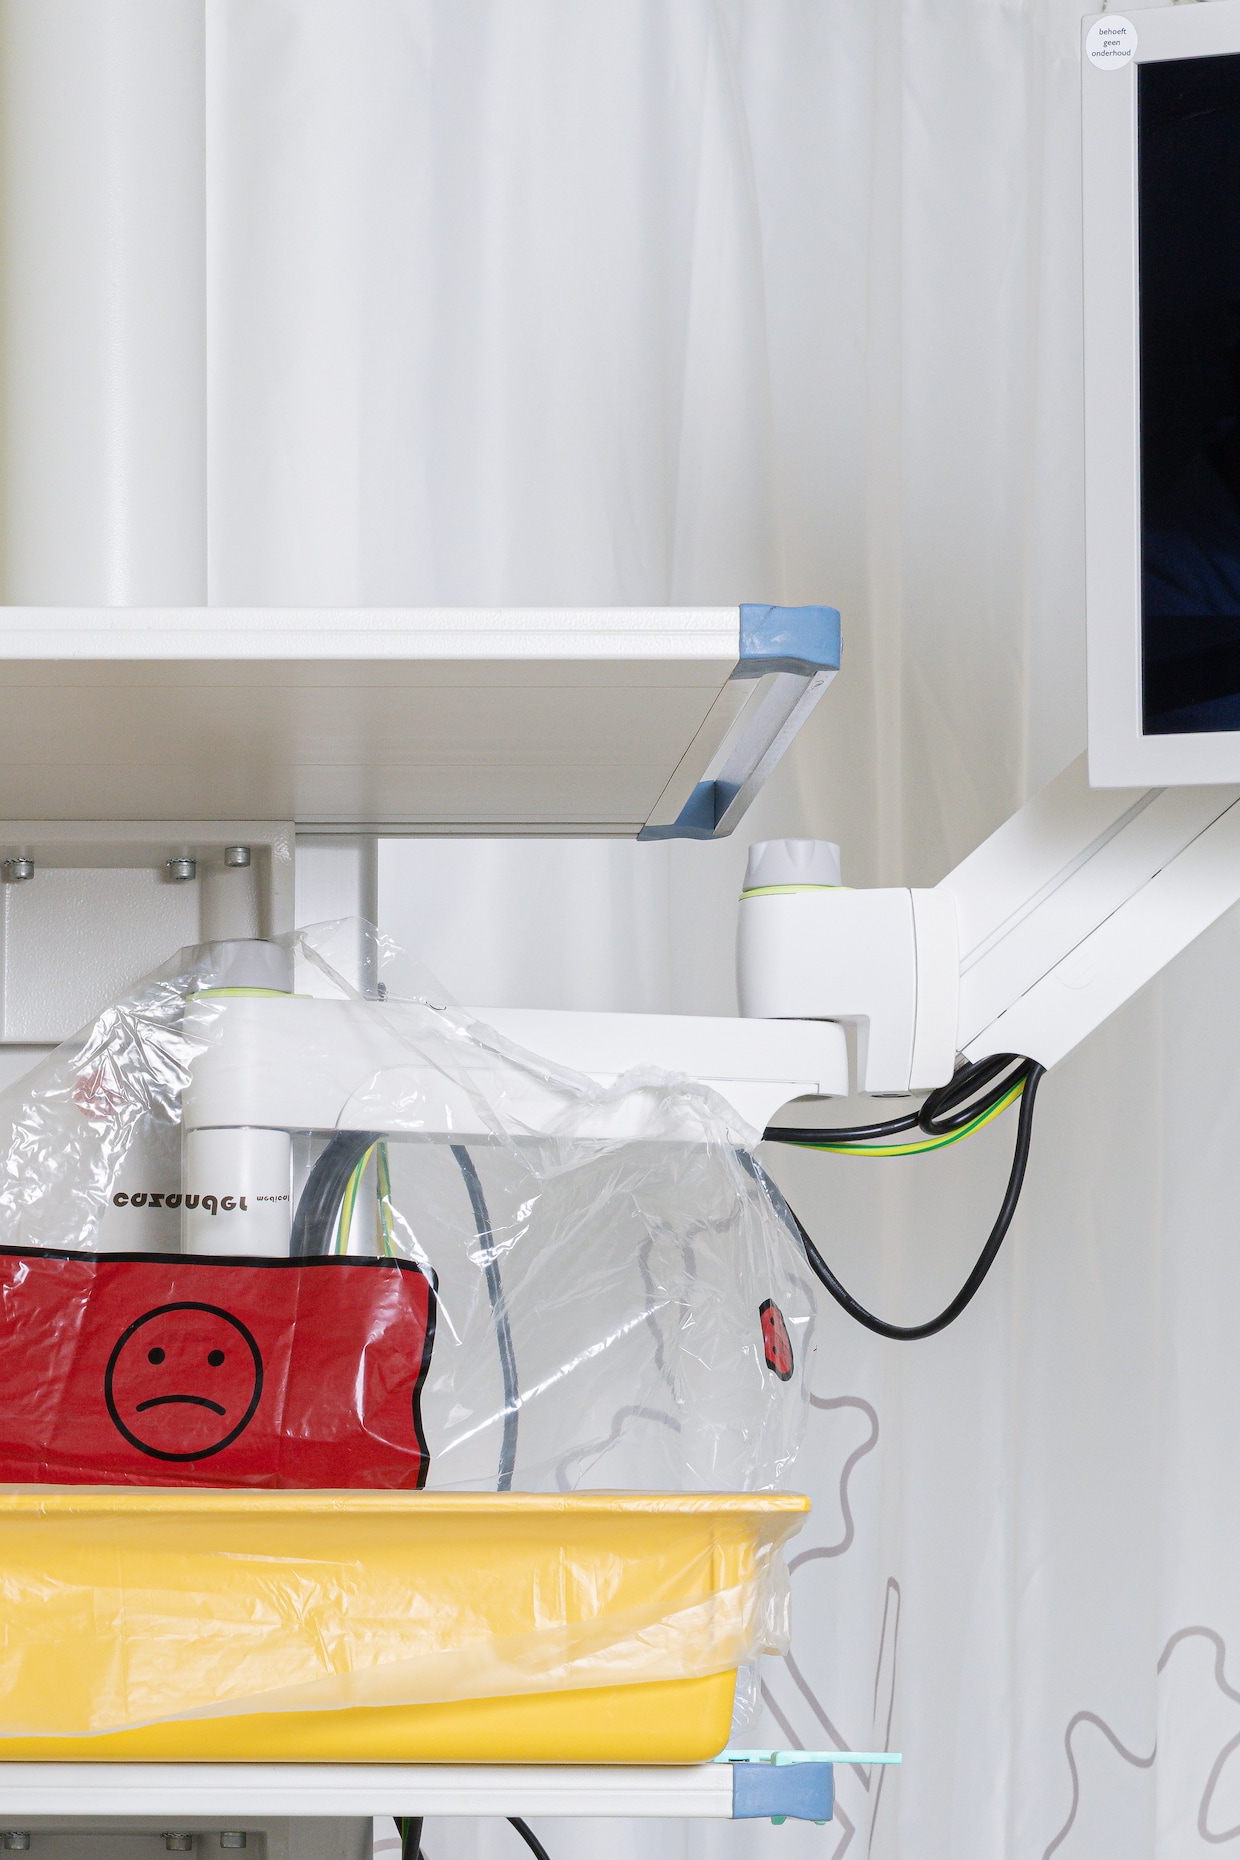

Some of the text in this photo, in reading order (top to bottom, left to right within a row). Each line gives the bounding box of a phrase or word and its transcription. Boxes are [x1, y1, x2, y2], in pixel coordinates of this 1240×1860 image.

[1098, 27, 1127, 36] behoeft
[1103, 38, 1121, 48] geen
[1091, 49, 1131, 57] onderhoud
